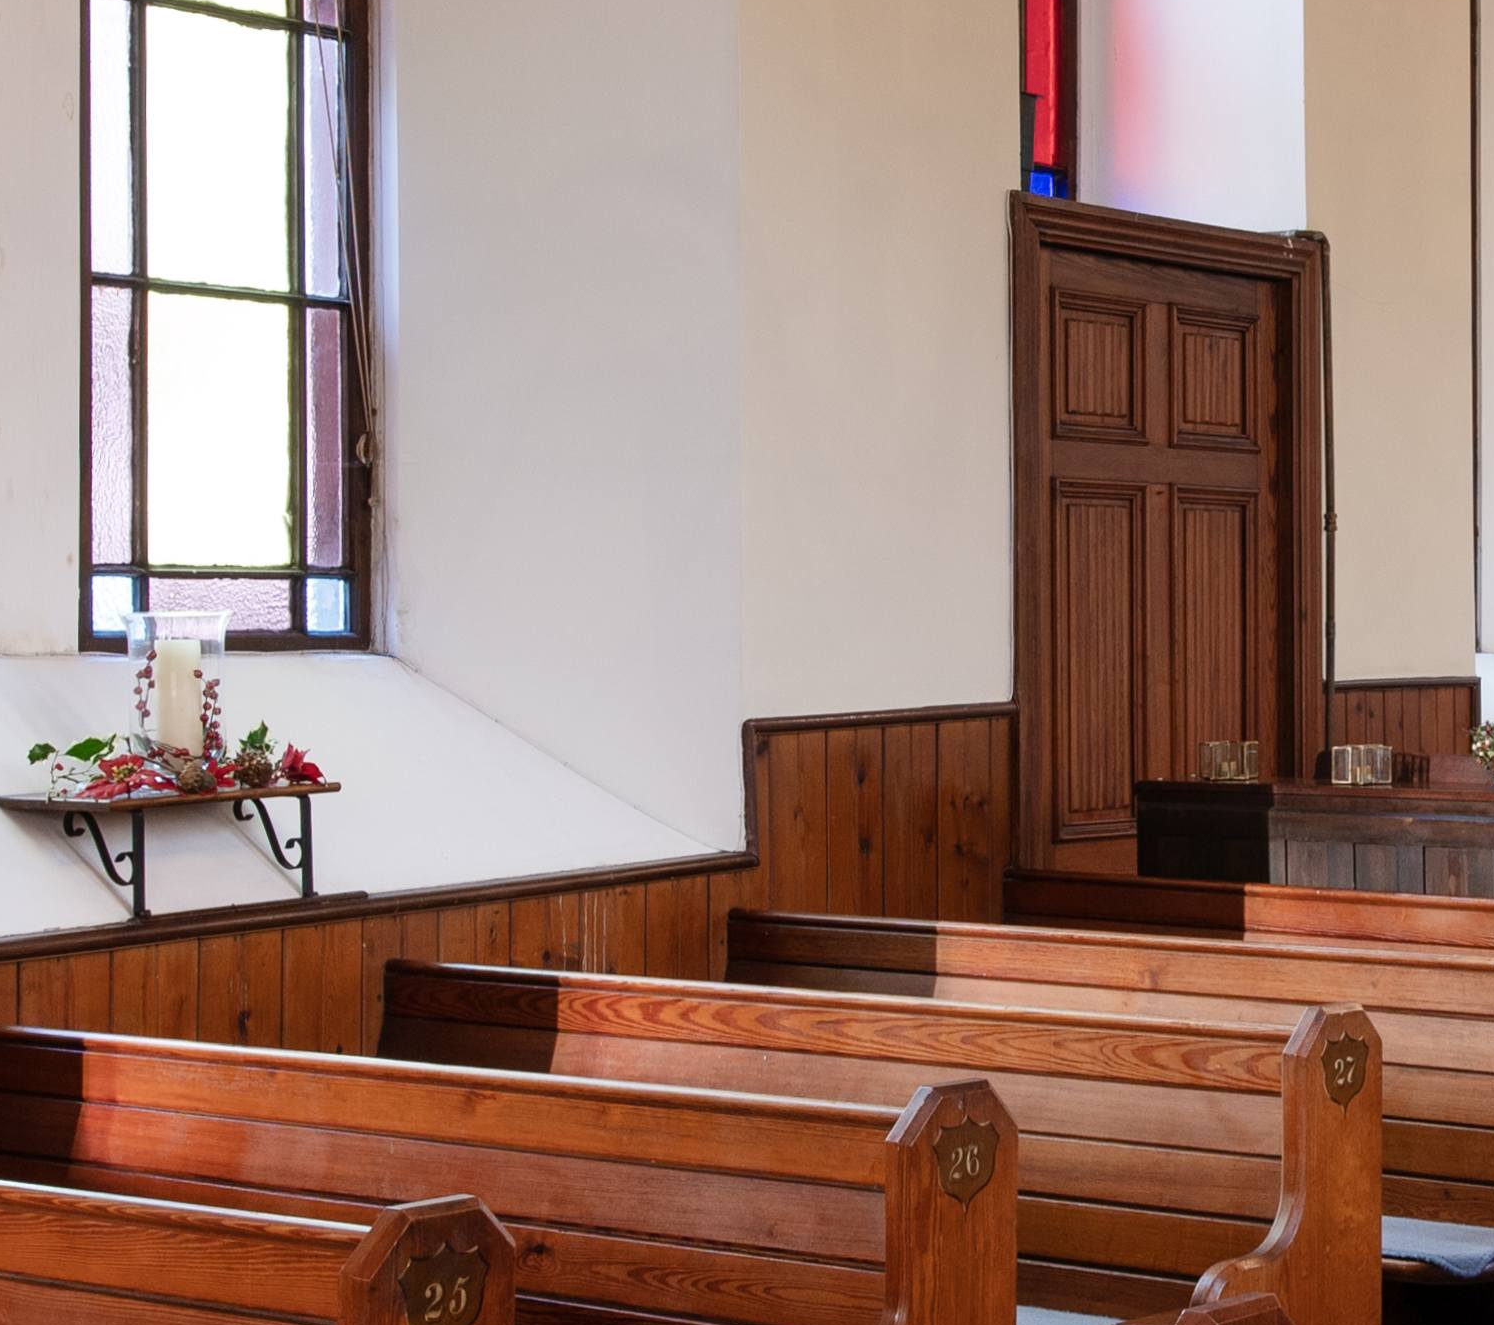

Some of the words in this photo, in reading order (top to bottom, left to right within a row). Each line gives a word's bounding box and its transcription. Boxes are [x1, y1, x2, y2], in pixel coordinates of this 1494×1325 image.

[1333, 1056, 1356, 1086] 27
[948, 1144, 980, 1180] 26
[424, 1275, 470, 1322] 25
